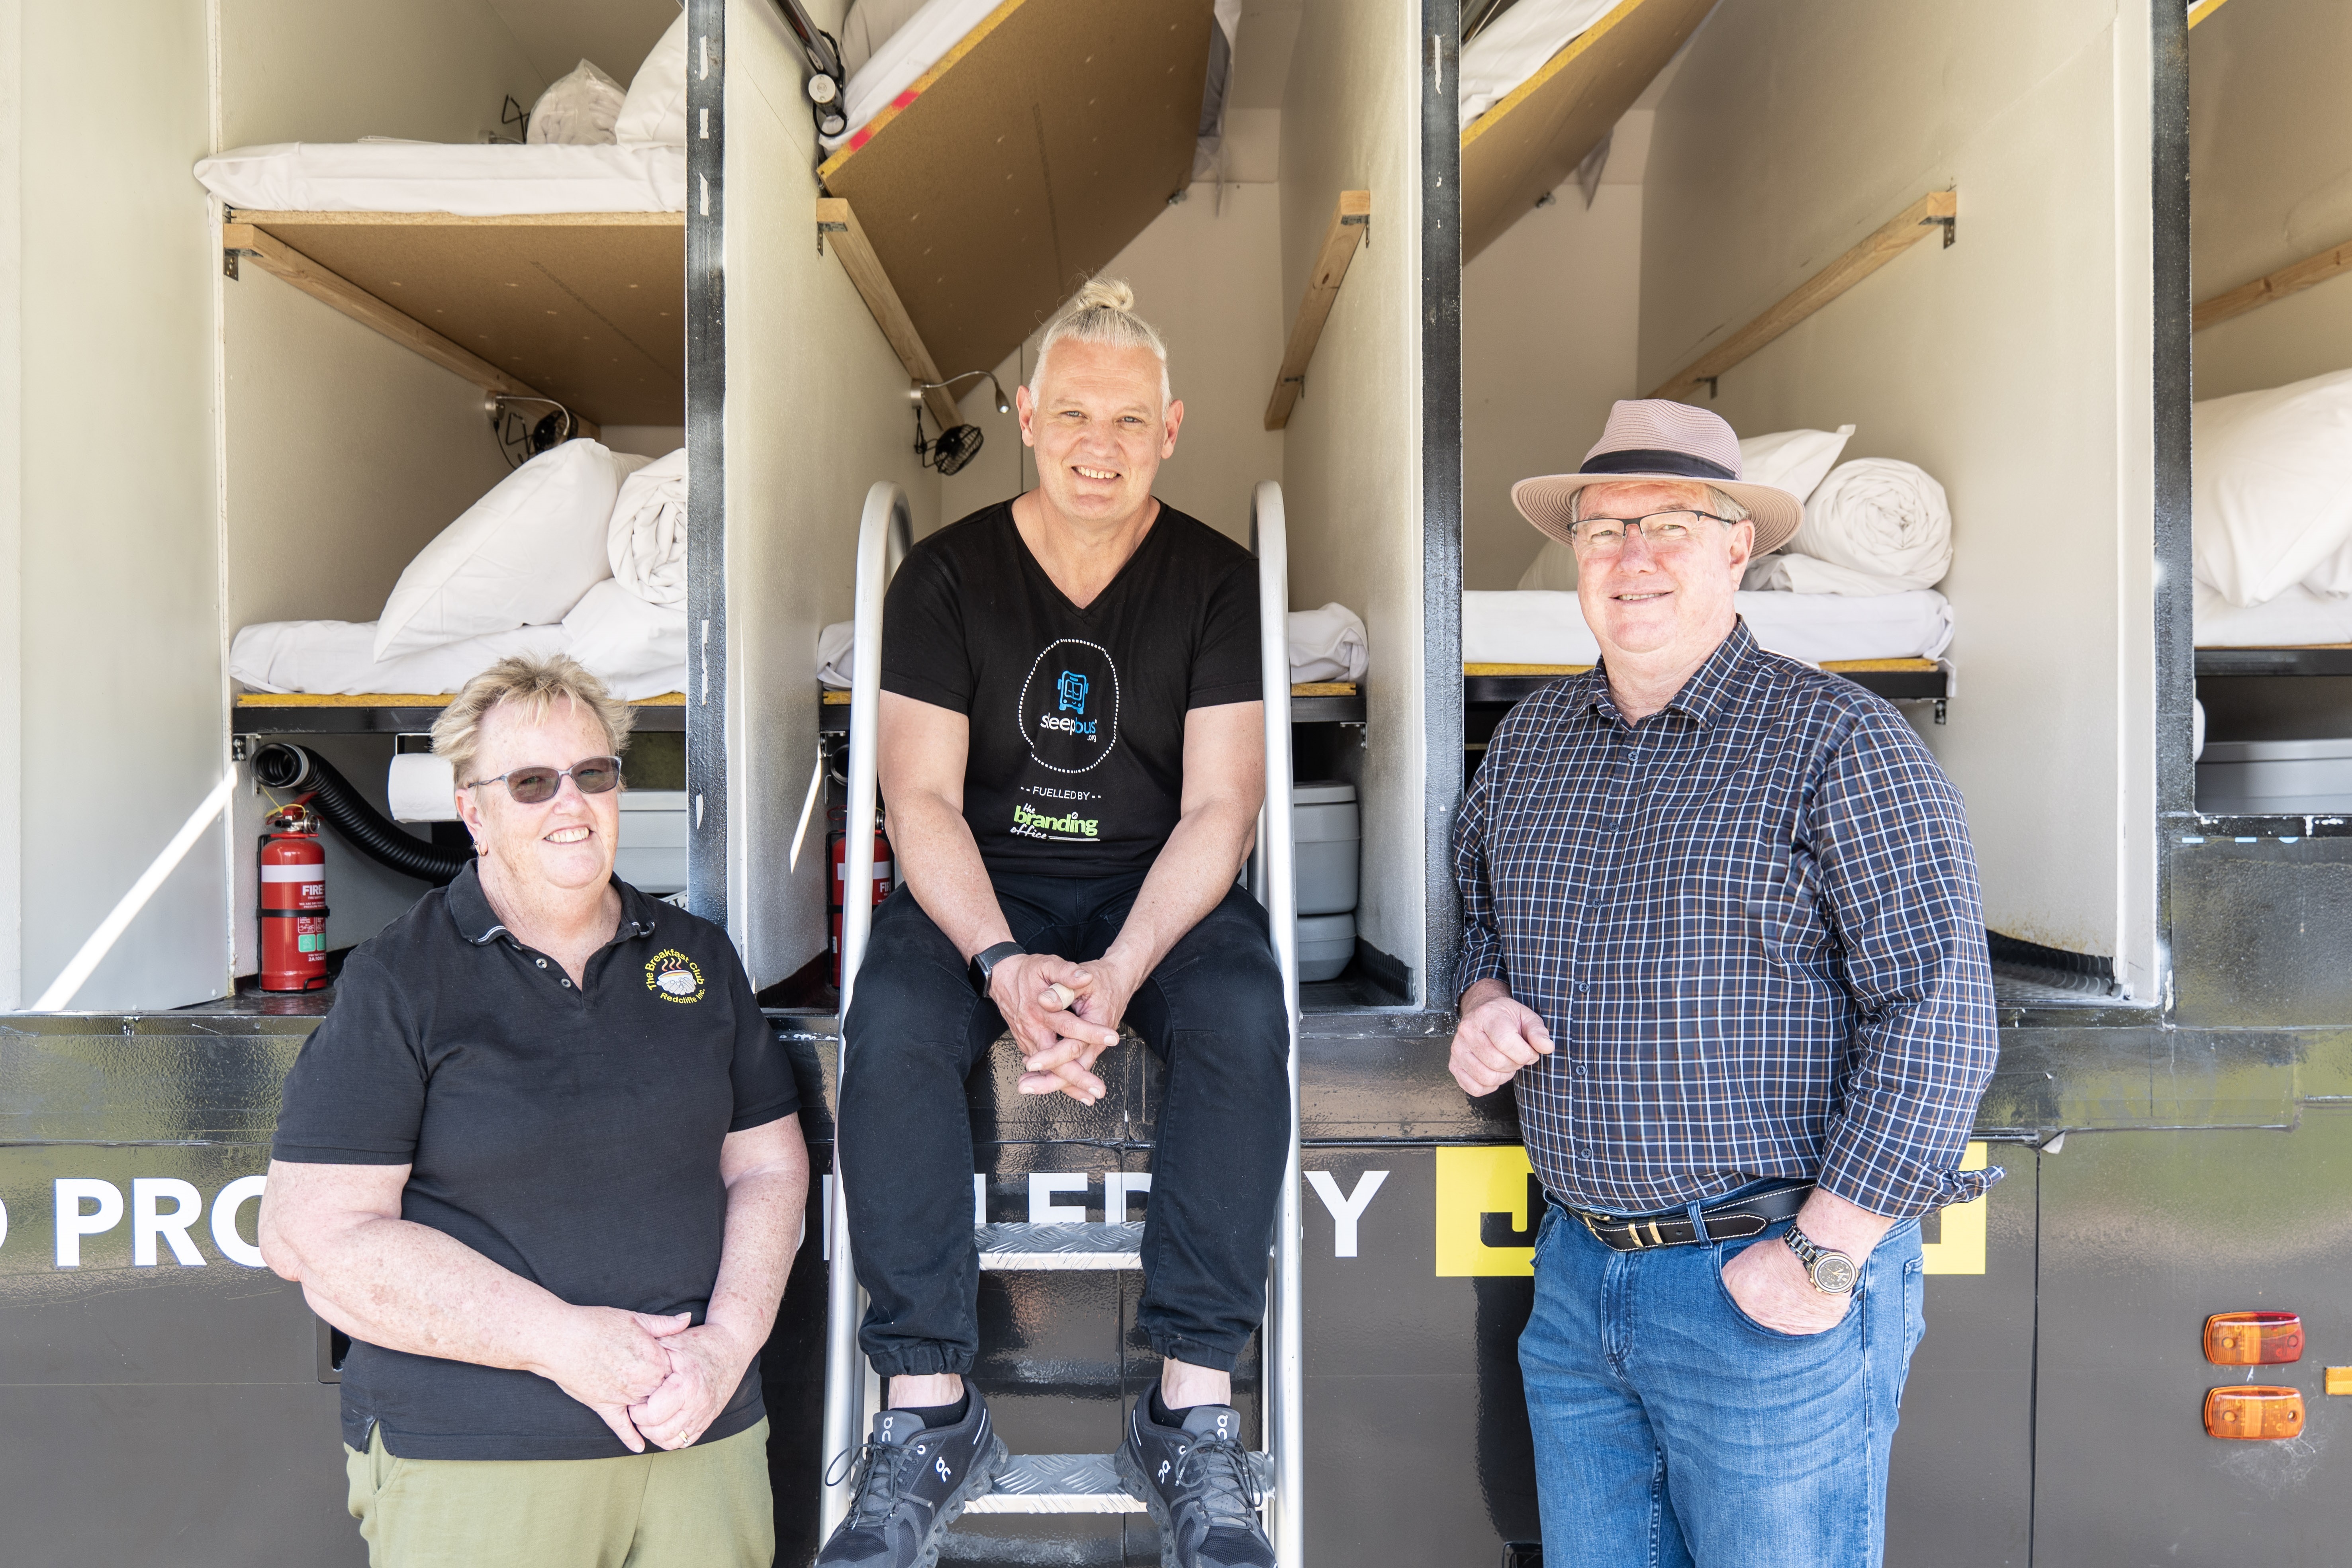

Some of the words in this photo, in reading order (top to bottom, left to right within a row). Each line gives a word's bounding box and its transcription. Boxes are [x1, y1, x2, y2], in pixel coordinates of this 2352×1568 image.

[1040, 712, 1097, 736] sleepbus
[1087, 734, 1097, 743] .org
[1023, 803, 1036, 814] the
[1014, 805, 1099, 836] branding
[1010, 823, 1047, 840] office
[302, 884, 323, 896] FIRE
[880, 881, 890, 893] FIR
[645, 949, 689, 971] Breakfast
[646, 972, 657, 991] The
[689, 962, 705, 985] Club
[660, 992, 697, 1004] Redcliffe
[695, 989, 705, 1000] Inc.
[55, 1175, 269, 1267] PRO
[1301, 1170, 1390, 1257] Y
